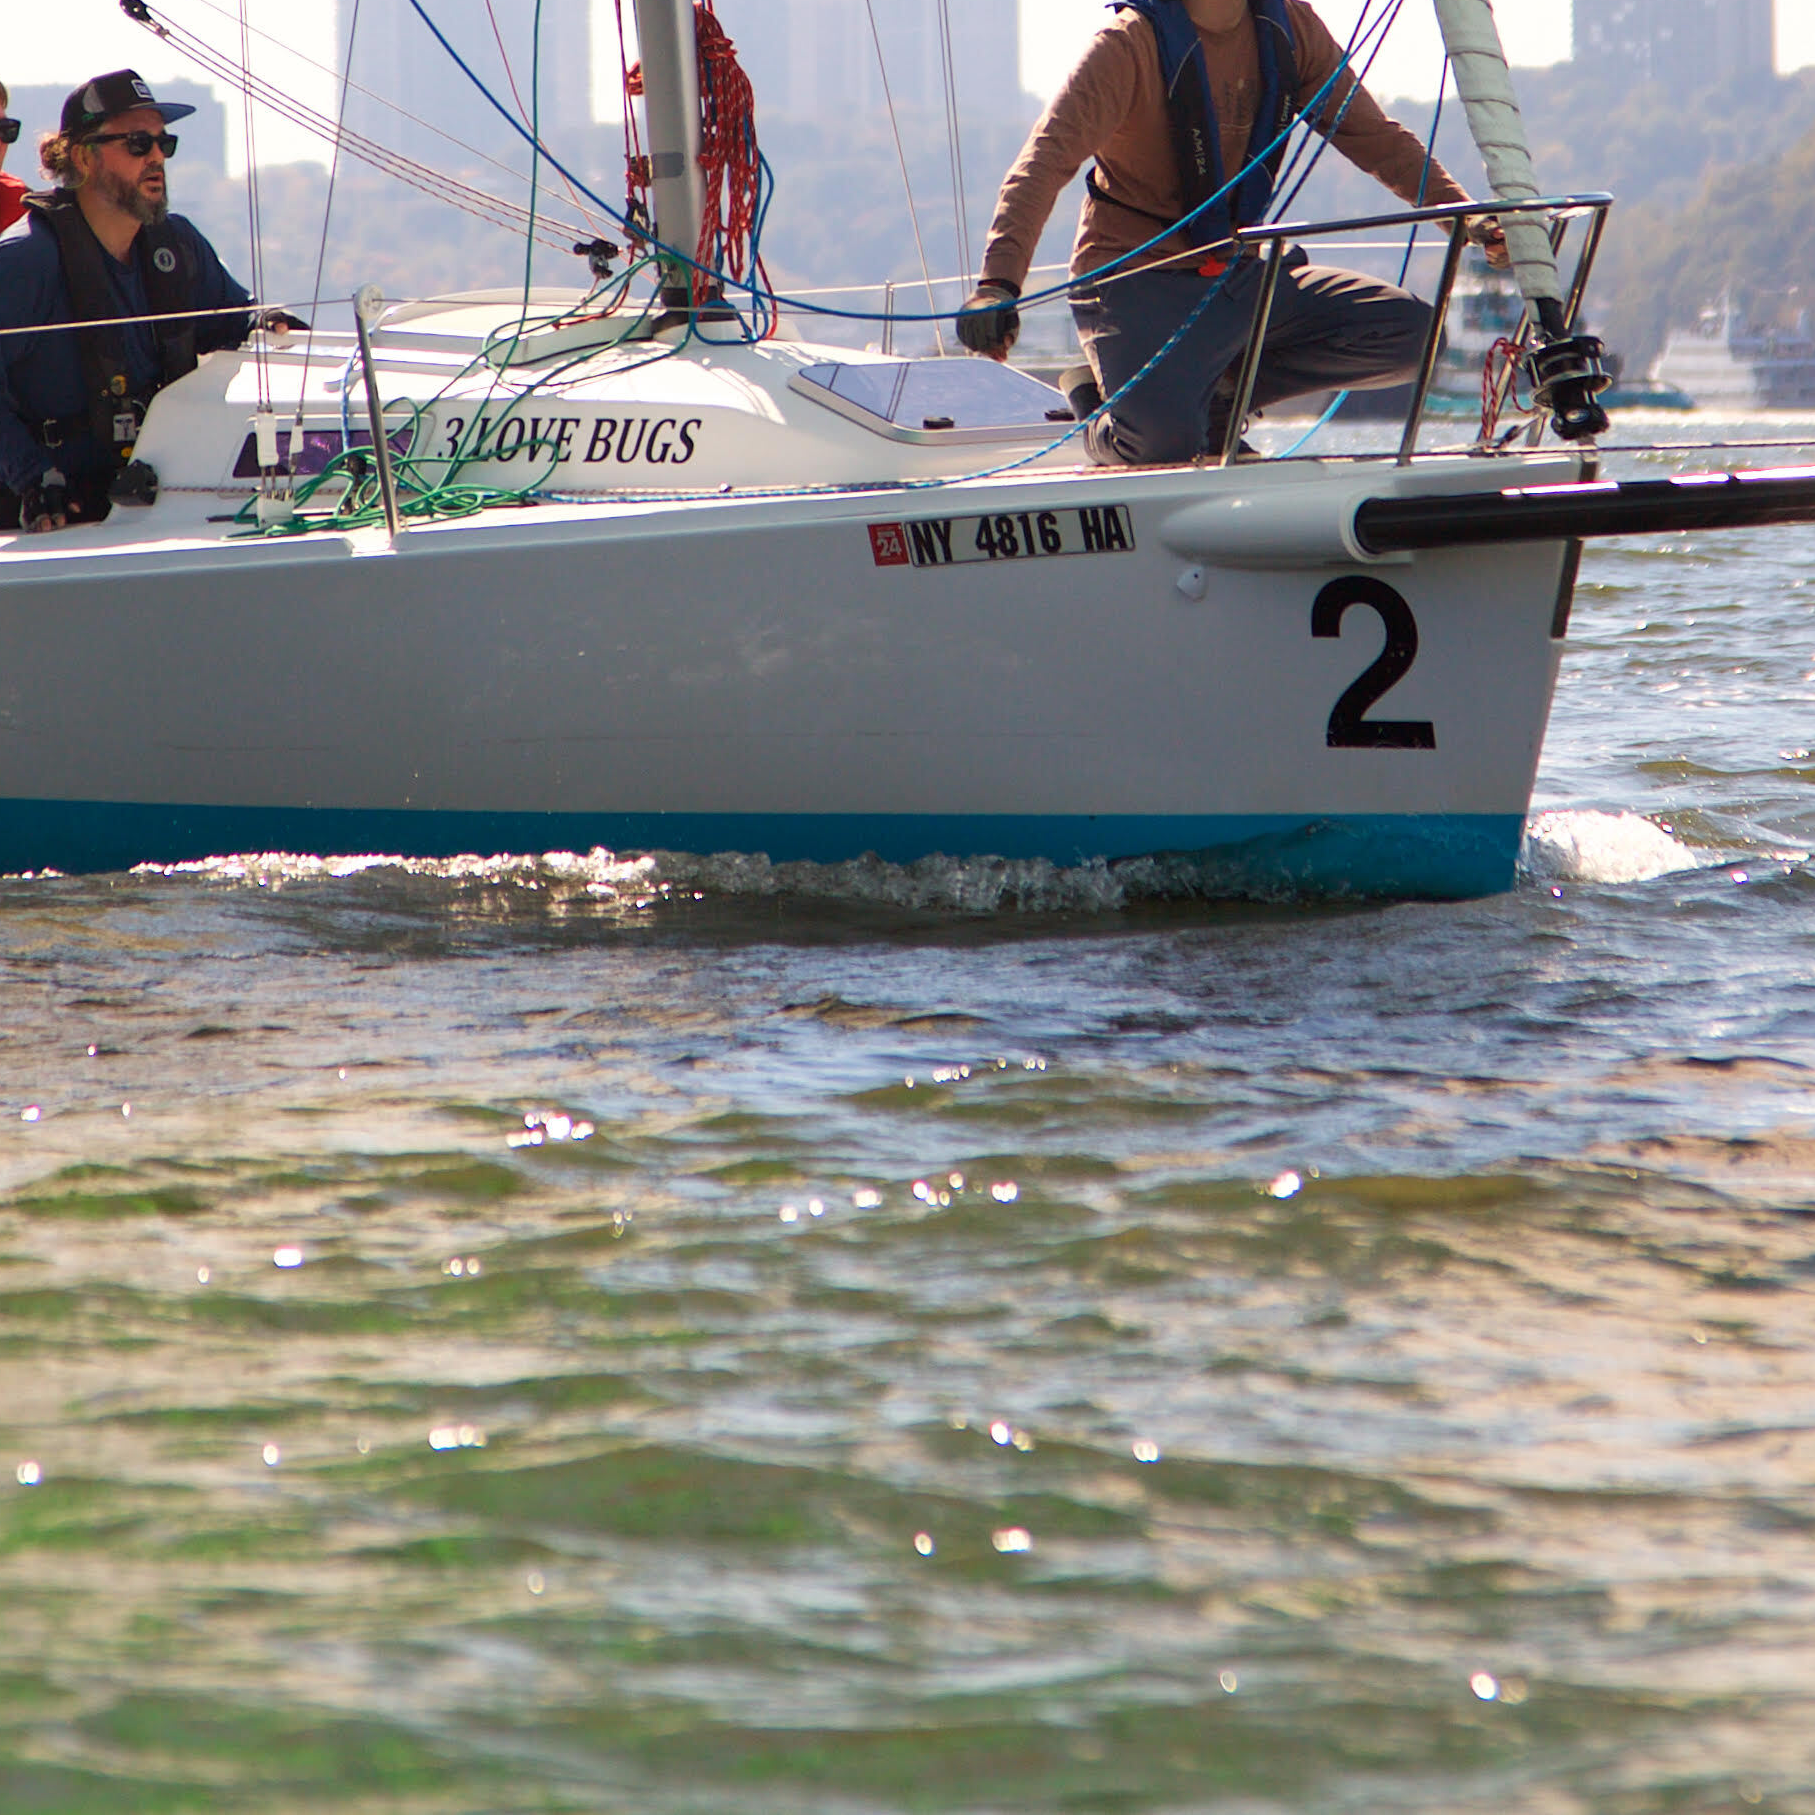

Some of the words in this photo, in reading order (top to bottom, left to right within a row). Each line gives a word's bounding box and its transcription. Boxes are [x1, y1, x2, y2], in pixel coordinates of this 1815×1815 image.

[437, 417, 464, 459] 3
[582, 418, 703, 464] BUGS
[910, 520, 953, 565] NY
[975, 512, 1062, 559] 4816
[1078, 506, 1129, 552] HA
[1311, 575, 1437, 748] 2
